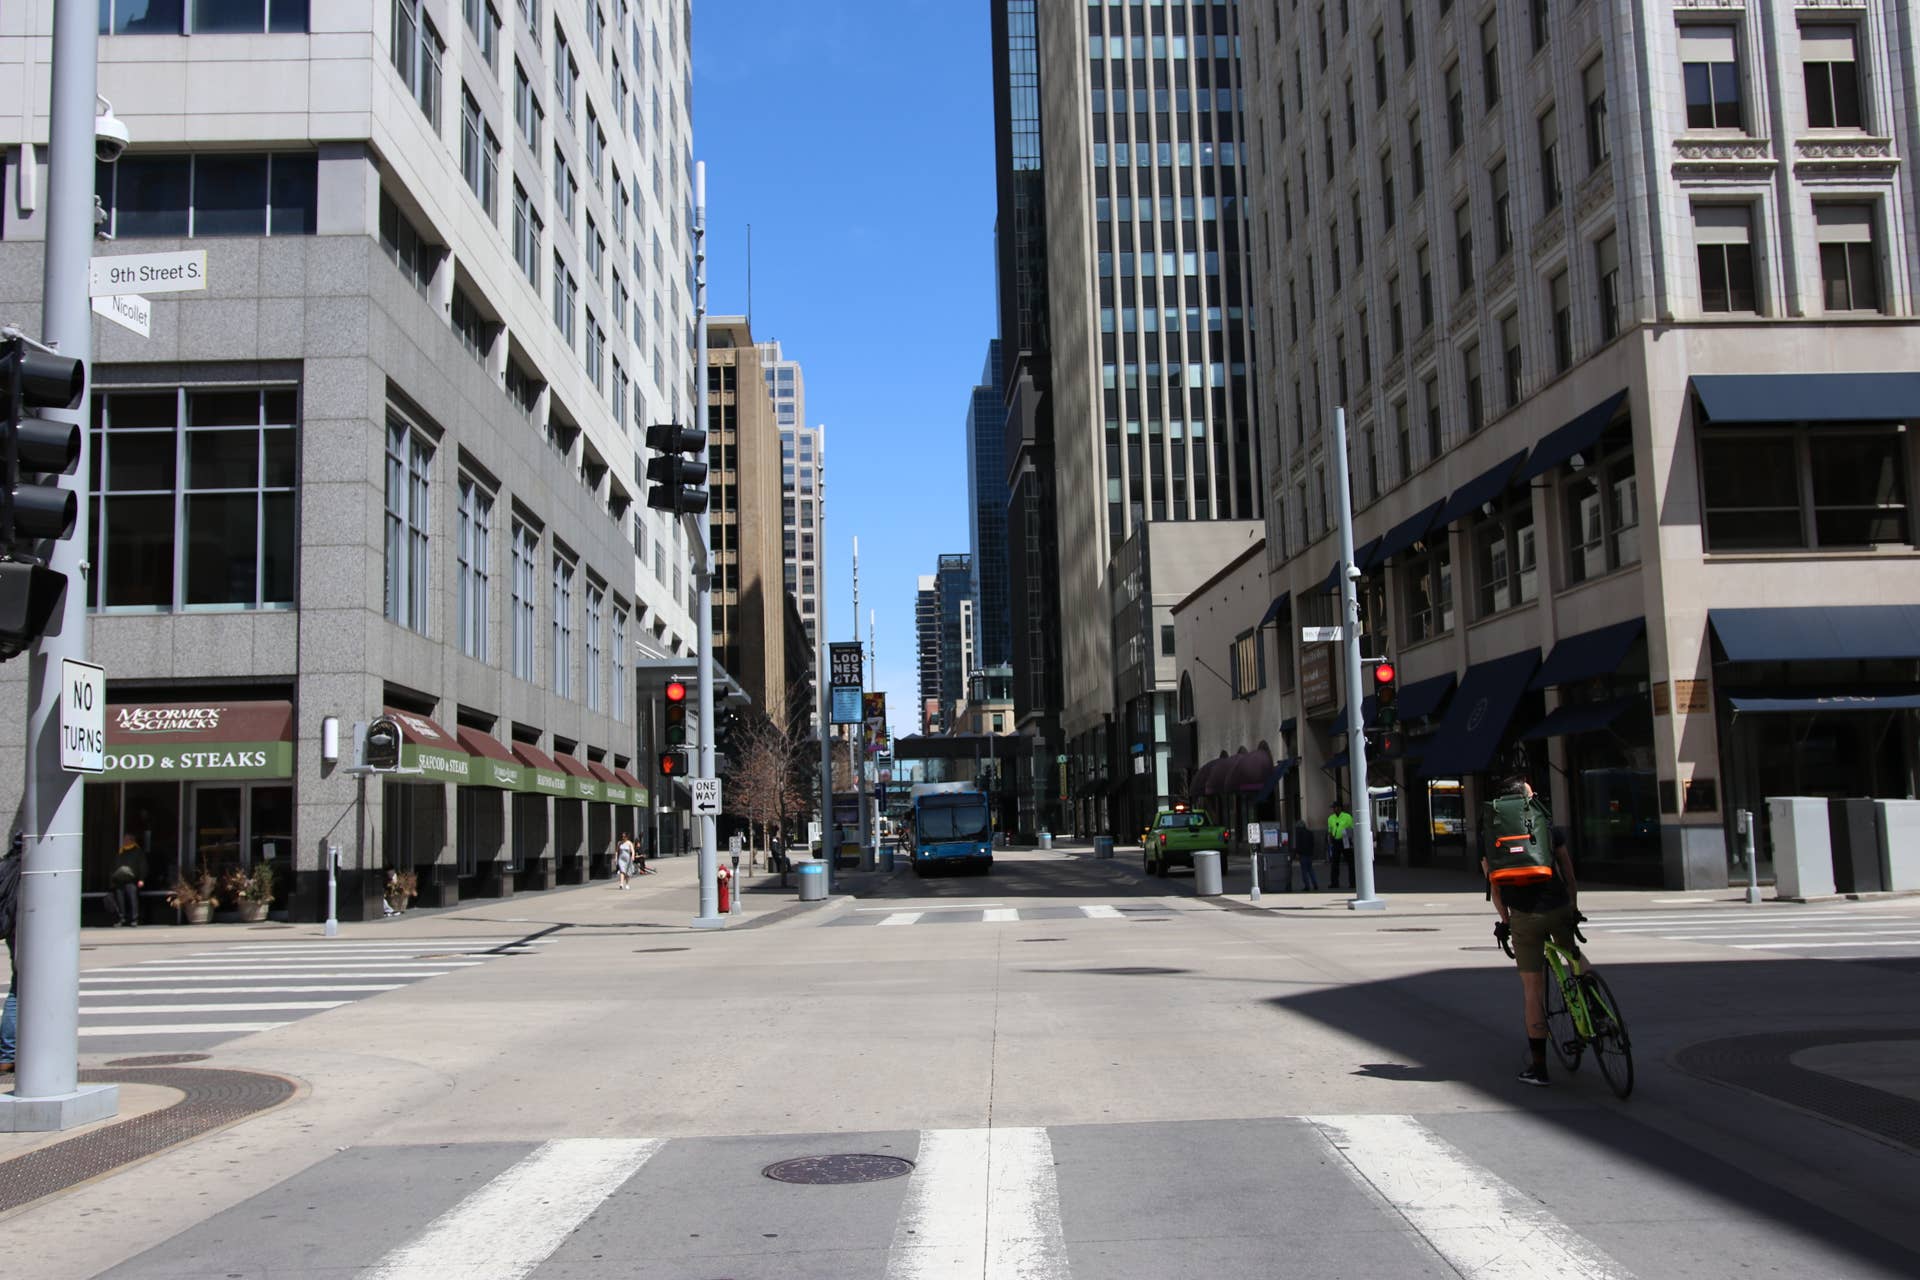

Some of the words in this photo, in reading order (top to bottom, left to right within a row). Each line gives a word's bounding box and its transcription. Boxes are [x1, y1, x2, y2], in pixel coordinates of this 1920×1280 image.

[110, 266, 136, 284] 9th
[139, 264, 184, 281] Street
[187, 262, 201, 279] S.
[112, 295, 148, 327] Nicollet
[833, 653, 859, 663] LOO
[833, 663, 860, 673] NES
[73, 680, 93, 712] NO
[63, 725, 102, 753] TURNS
[160, 757, 175, 768] &
[180, 751, 267, 768] STEAKS
[696, 782, 716, 790] ONE
[695, 792, 716, 801] WAY
